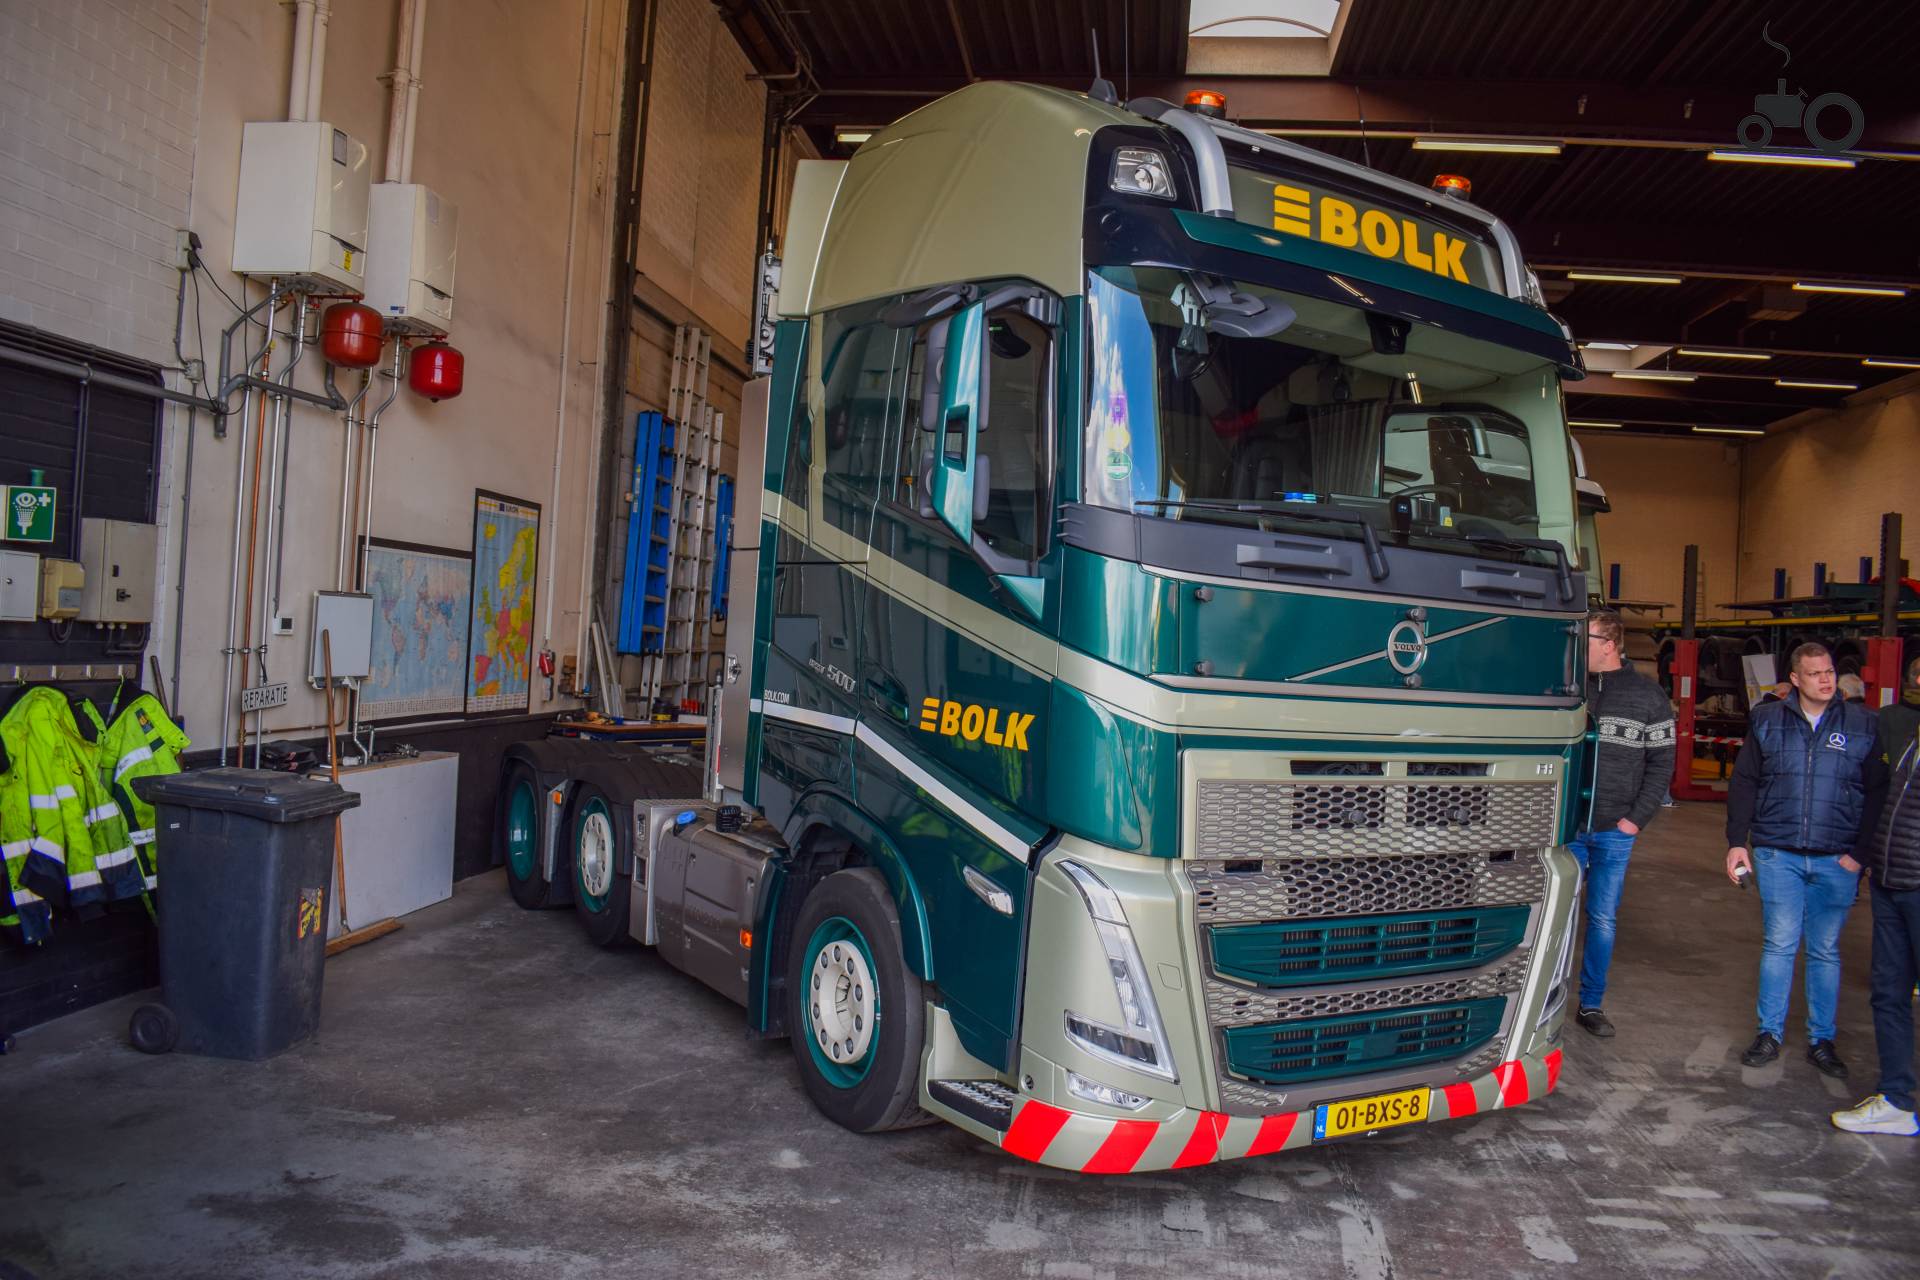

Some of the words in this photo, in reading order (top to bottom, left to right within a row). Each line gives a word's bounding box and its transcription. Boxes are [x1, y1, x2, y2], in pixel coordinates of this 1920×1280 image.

[1320, 196, 1470, 284] BOLK
[1394, 643, 1421, 651] VOLVO
[827, 664, 856, 693] 500
[244, 686, 288, 709] REPARATIE
[764, 689, 790, 704] BOLK.COM
[940, 700, 1035, 751] BOLK
[1536, 763, 1553, 775] FH
[1336, 1095, 1420, 1130] 01-BXS-8
